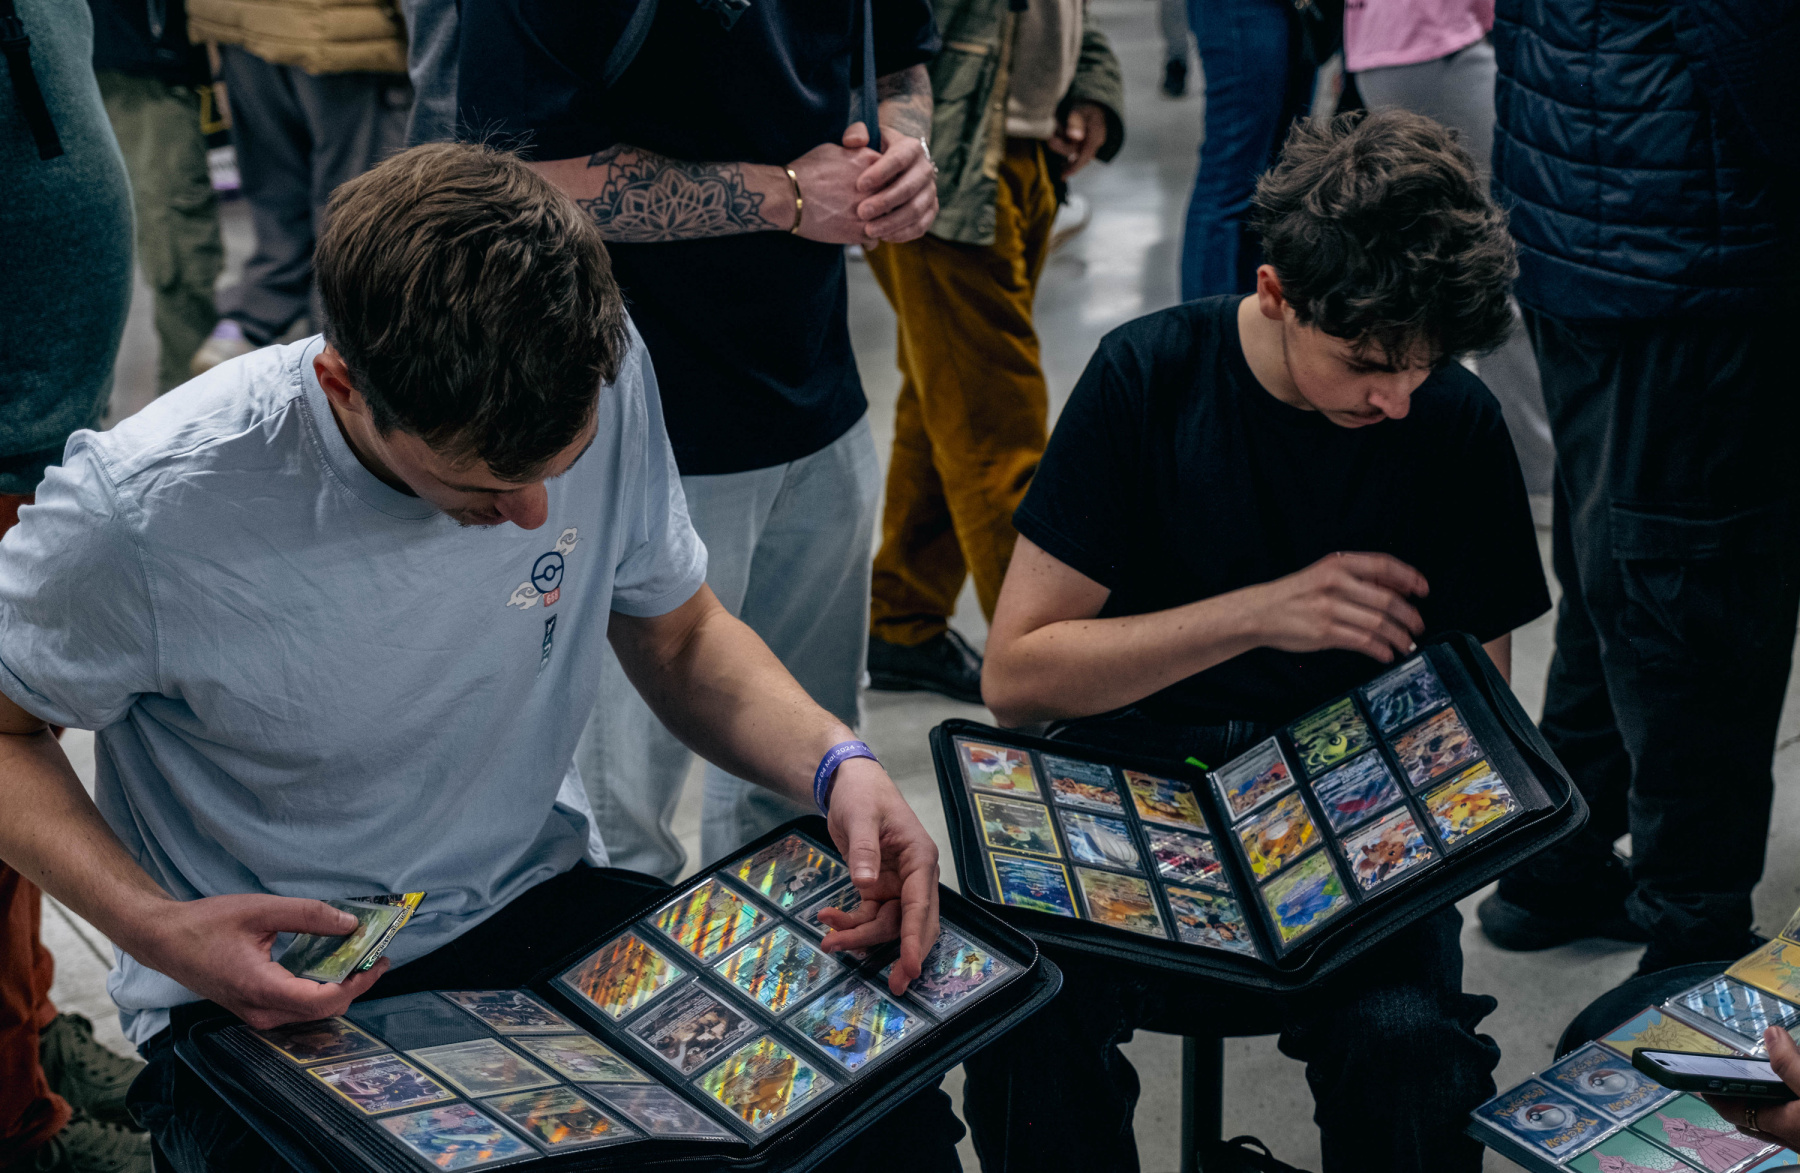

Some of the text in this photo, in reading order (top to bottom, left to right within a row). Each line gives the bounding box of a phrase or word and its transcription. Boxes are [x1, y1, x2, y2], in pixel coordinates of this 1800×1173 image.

[819, 767, 826, 778] 04
[825, 754, 836, 768] Mai
[835, 744, 855, 756] 2024
